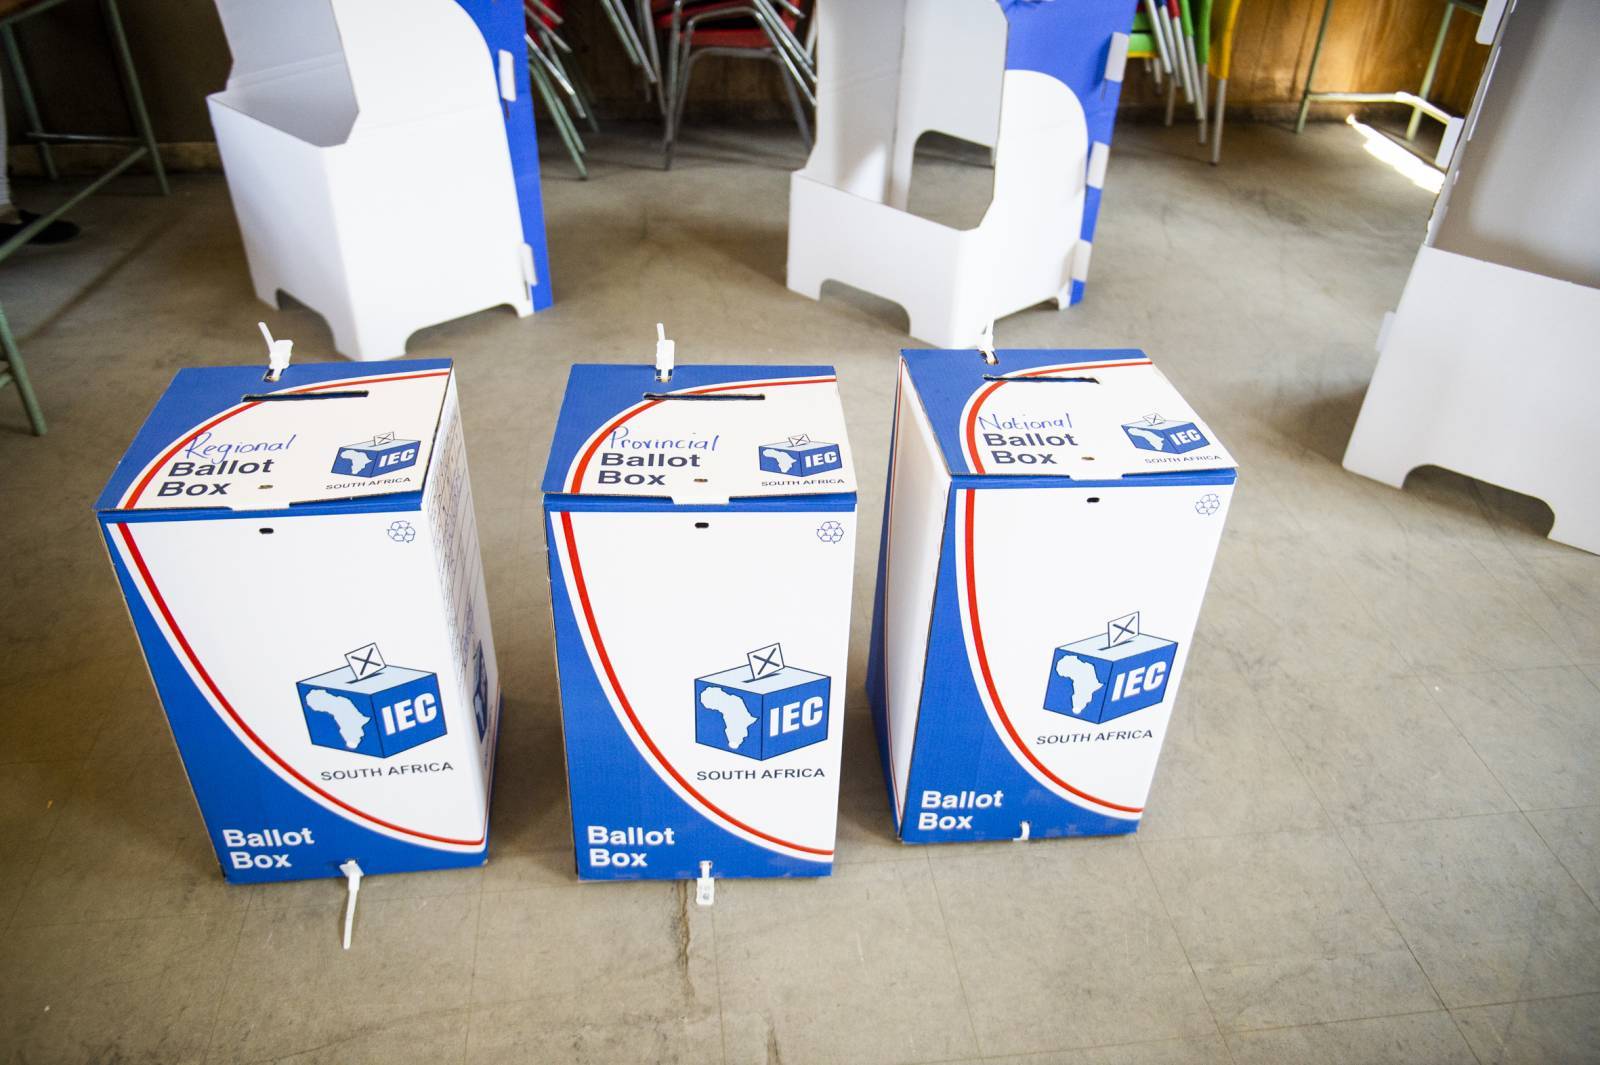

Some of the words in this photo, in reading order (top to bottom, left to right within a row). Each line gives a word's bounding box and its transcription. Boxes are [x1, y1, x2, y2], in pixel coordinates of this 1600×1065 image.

[978, 413, 1073, 430] National
[610, 425, 720, 452] Provincial
[983, 433, 1079, 447] Ballot
[1170, 427, 1201, 446] IEC
[184, 432, 297, 463] Regional
[378, 448, 416, 468] IEC
[600, 452, 701, 468] Ballot
[804, 451, 838, 469] IEC
[990, 450, 1058, 465] Box
[1144, 456, 1182, 464] SOUTH
[167, 459, 275, 477] Ballot
[325, 482, 365, 491] SOUTH
[368, 477, 412, 487] AFRICA
[598, 470, 666, 486] Box
[802, 478, 846, 486] AFRICA
[157, 481, 231, 497] Box
[1111, 661, 1168, 702] IEC
[381, 692, 438, 736] IEC
[769, 696, 824, 737] IEC
[1036, 734, 1091, 745] SOUTH
[1095, 729, 1153, 742] AFRICA
[320, 767, 383, 781] SOUTH
[388, 761, 454, 777] AFRICA
[696, 770, 756, 781] SOUTH
[761, 768, 825, 779] AFRICA
[921, 790, 1004, 809] Ballot
[918, 812, 973, 831] Box
[222, 827, 316, 848] Ballot
[587, 825, 676, 846] Ballot
[229, 851, 293, 870] Box
[589, 848, 649, 868] Box
